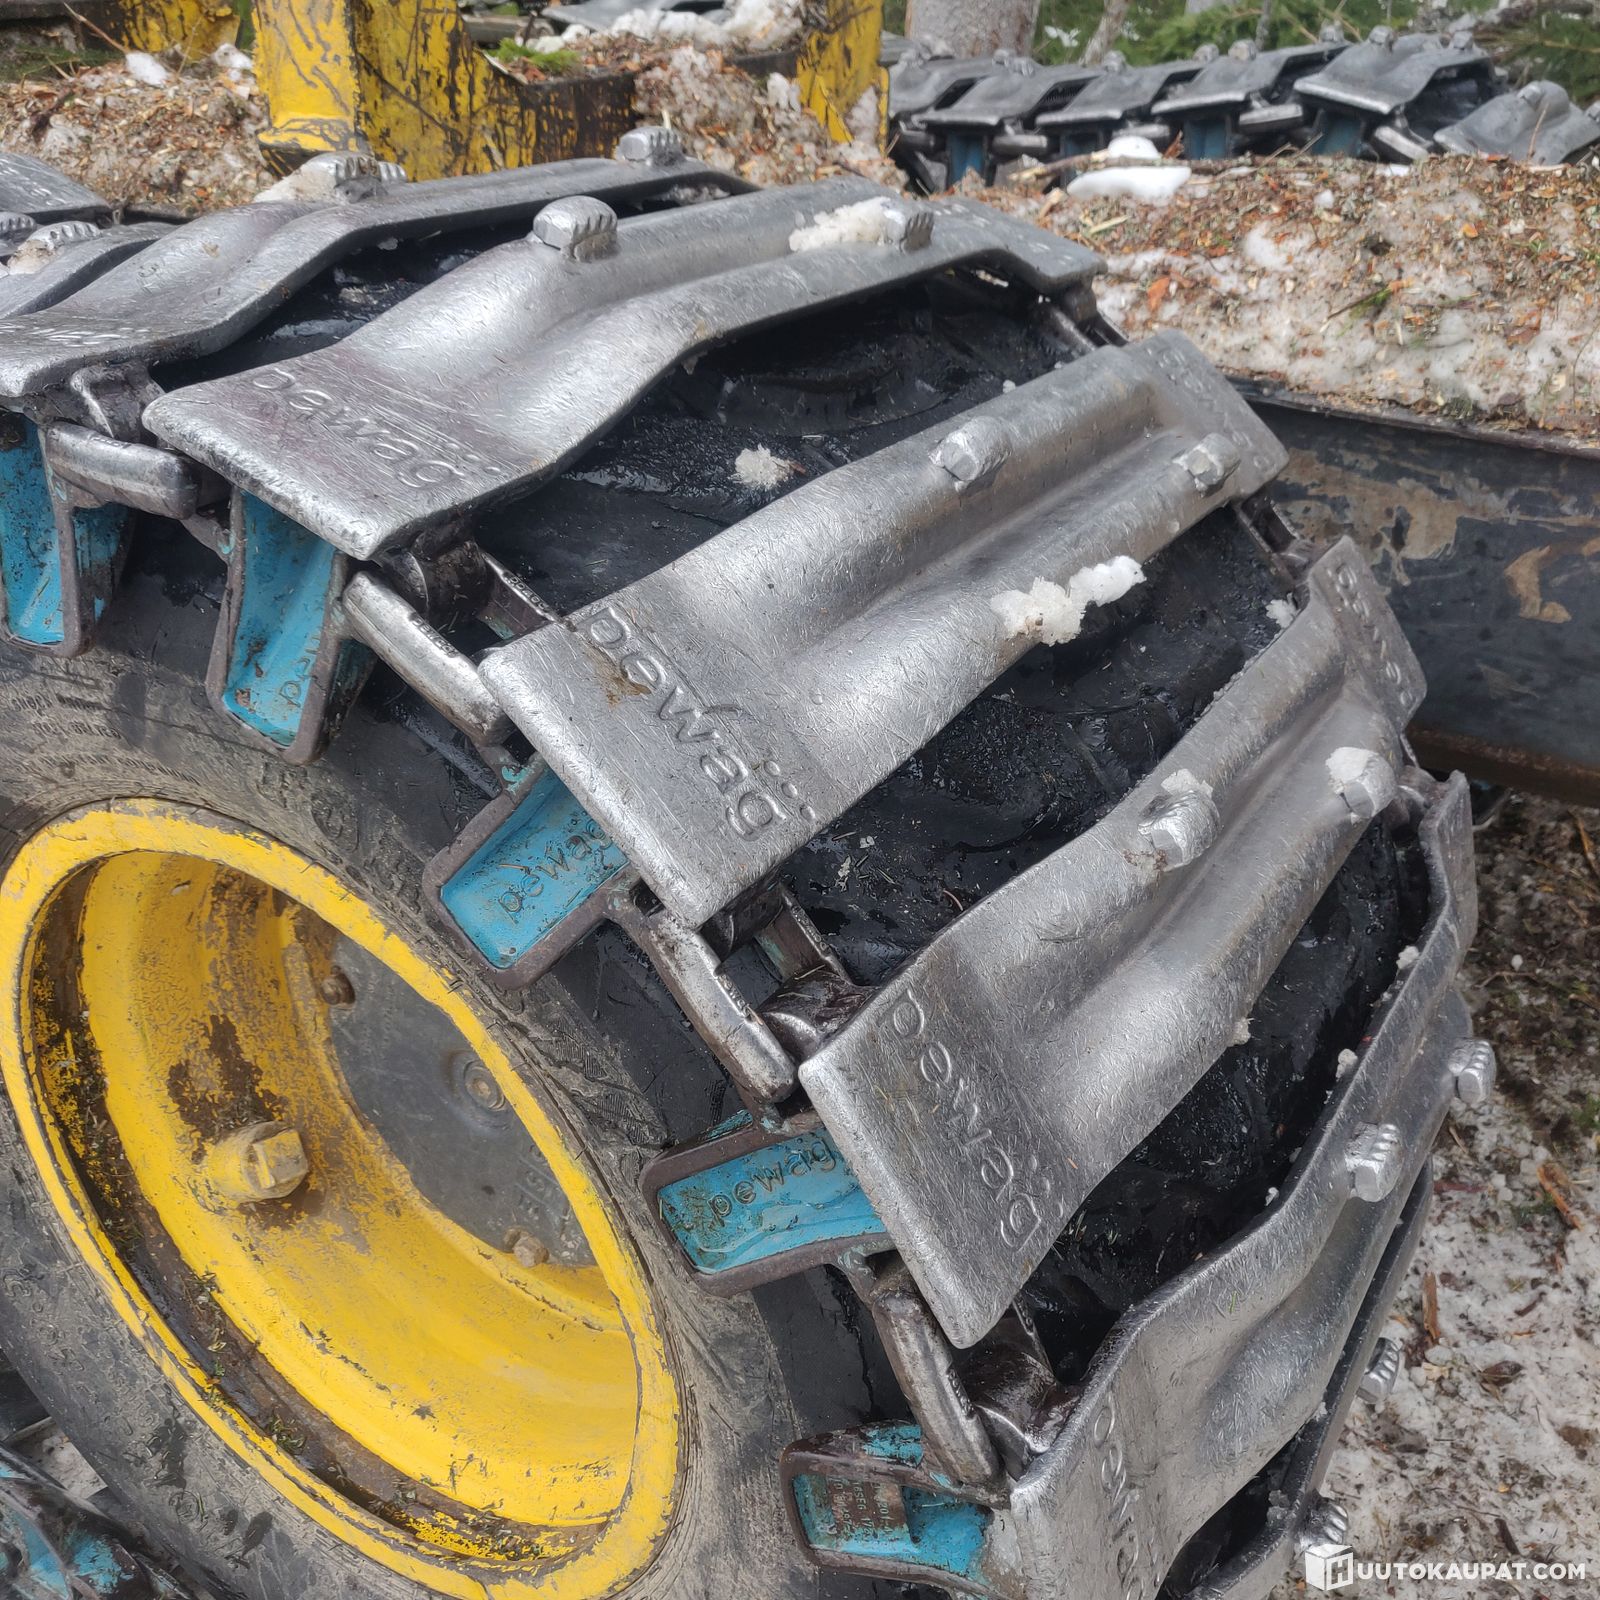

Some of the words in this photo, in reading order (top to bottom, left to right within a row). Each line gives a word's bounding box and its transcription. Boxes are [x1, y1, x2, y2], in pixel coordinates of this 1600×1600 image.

[576, 605, 786, 842] pewag
[498, 818, 614, 925] pewag
[706, 1136, 836, 1227] pewag
[877, 988, 1042, 1252] pewag
